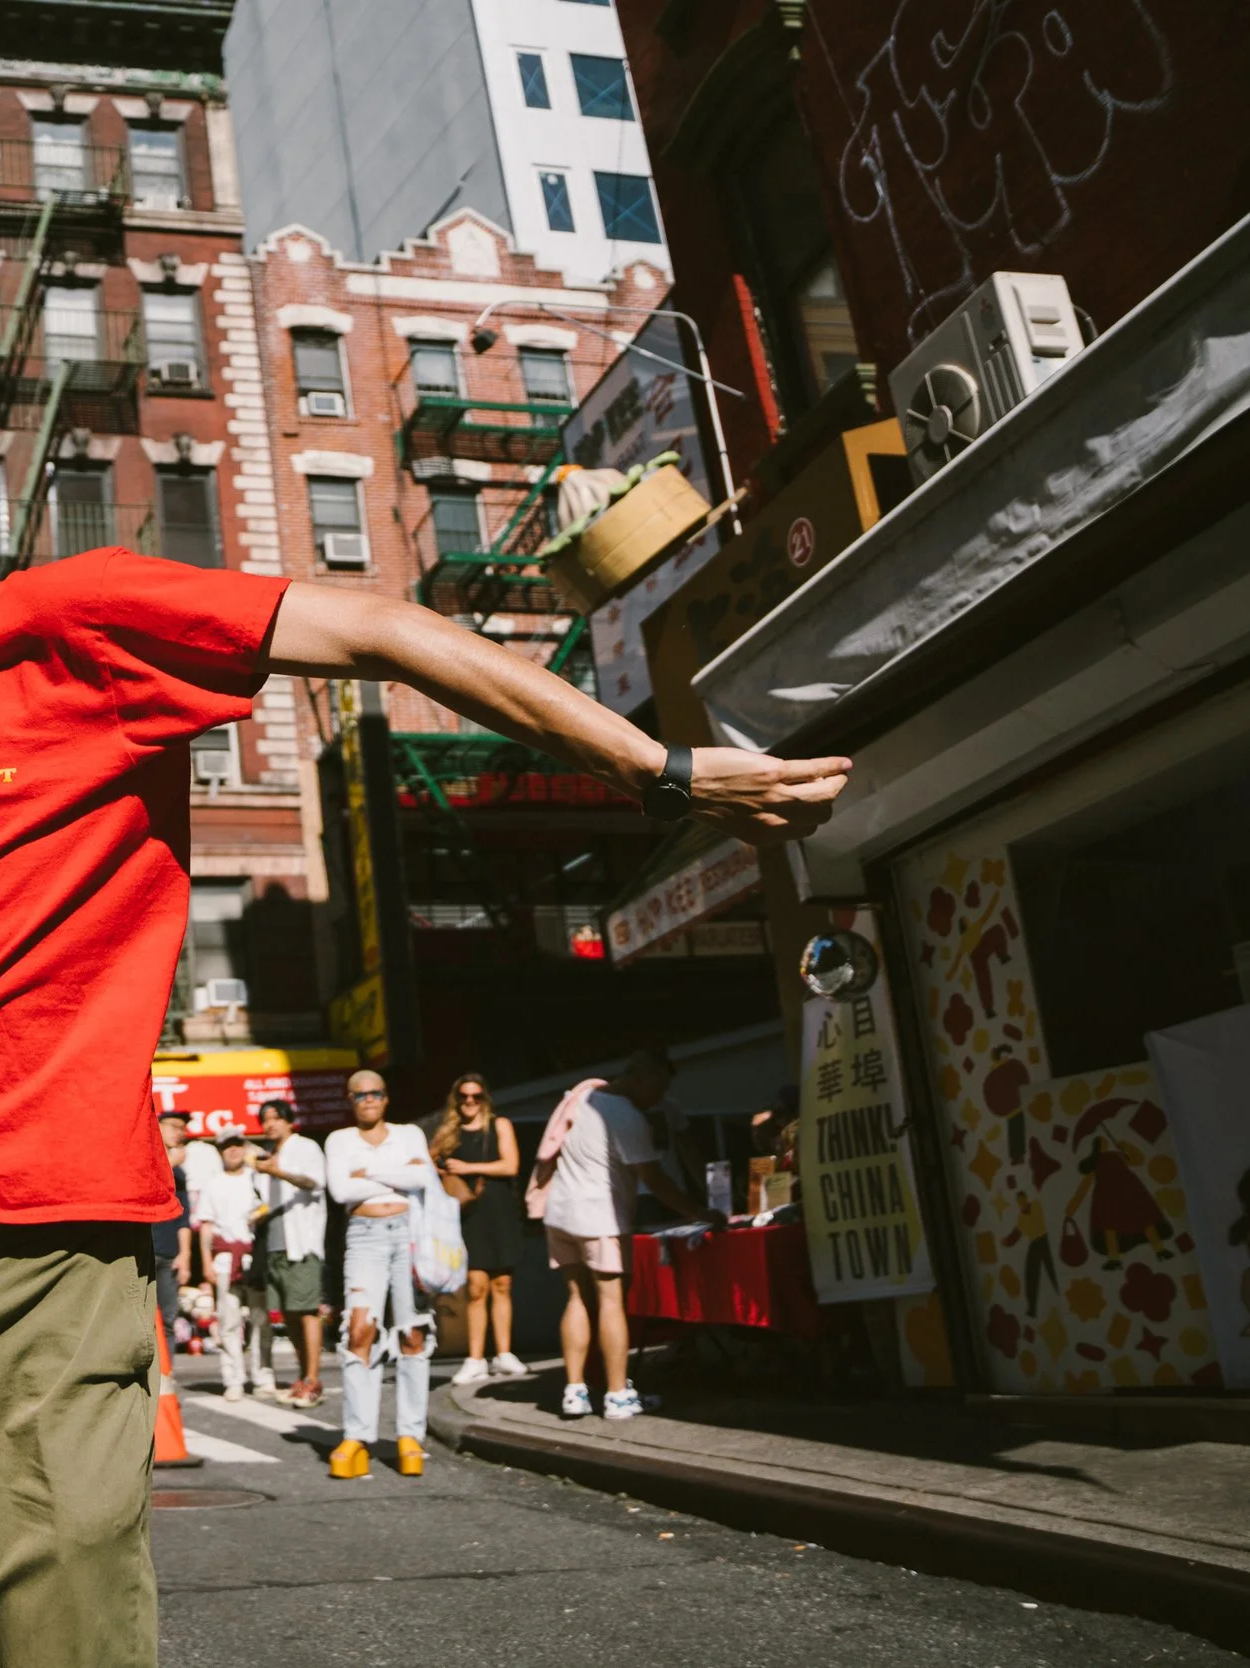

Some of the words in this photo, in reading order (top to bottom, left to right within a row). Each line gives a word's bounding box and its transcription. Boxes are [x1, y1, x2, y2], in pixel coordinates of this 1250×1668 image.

[792, 525, 811, 560] 21
[815, 1102, 898, 1164] THINK!
[819, 1163, 906, 1223] CHINA
[827, 1222, 913, 1282] TOWN
